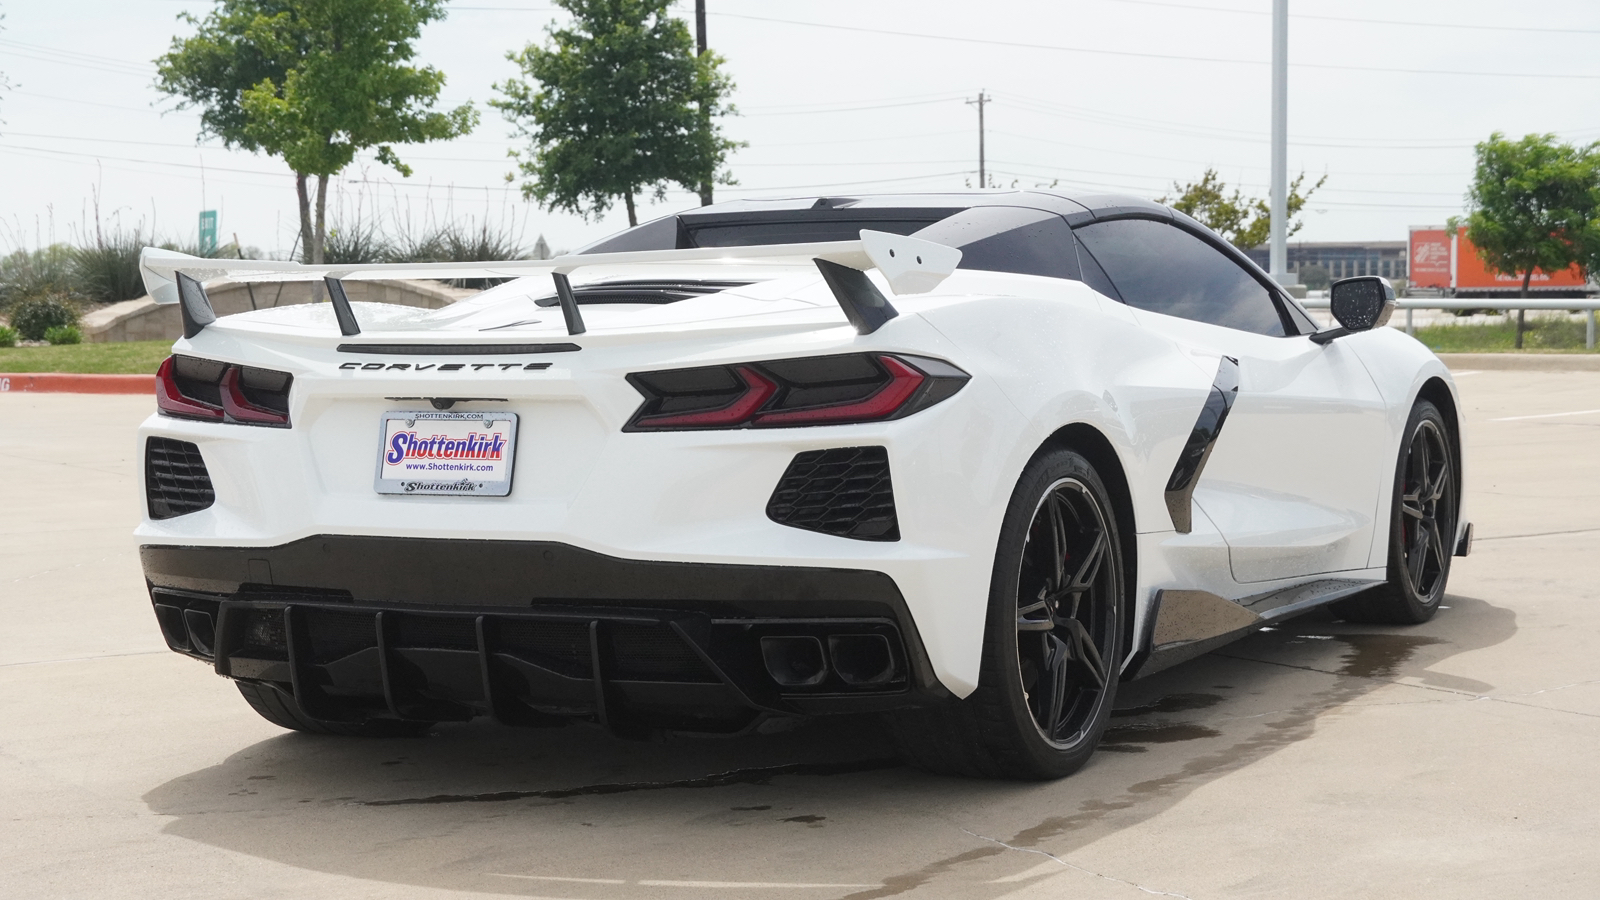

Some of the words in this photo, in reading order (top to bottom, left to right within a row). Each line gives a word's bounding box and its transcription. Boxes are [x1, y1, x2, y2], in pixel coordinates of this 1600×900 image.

[339, 362, 553, 371] CORVETTE
[386, 431, 507, 466] Shottenkirk
[405, 463, 494, 472] www.Shottenkirk.com
[404, 481, 477, 492] Shottenkirk
